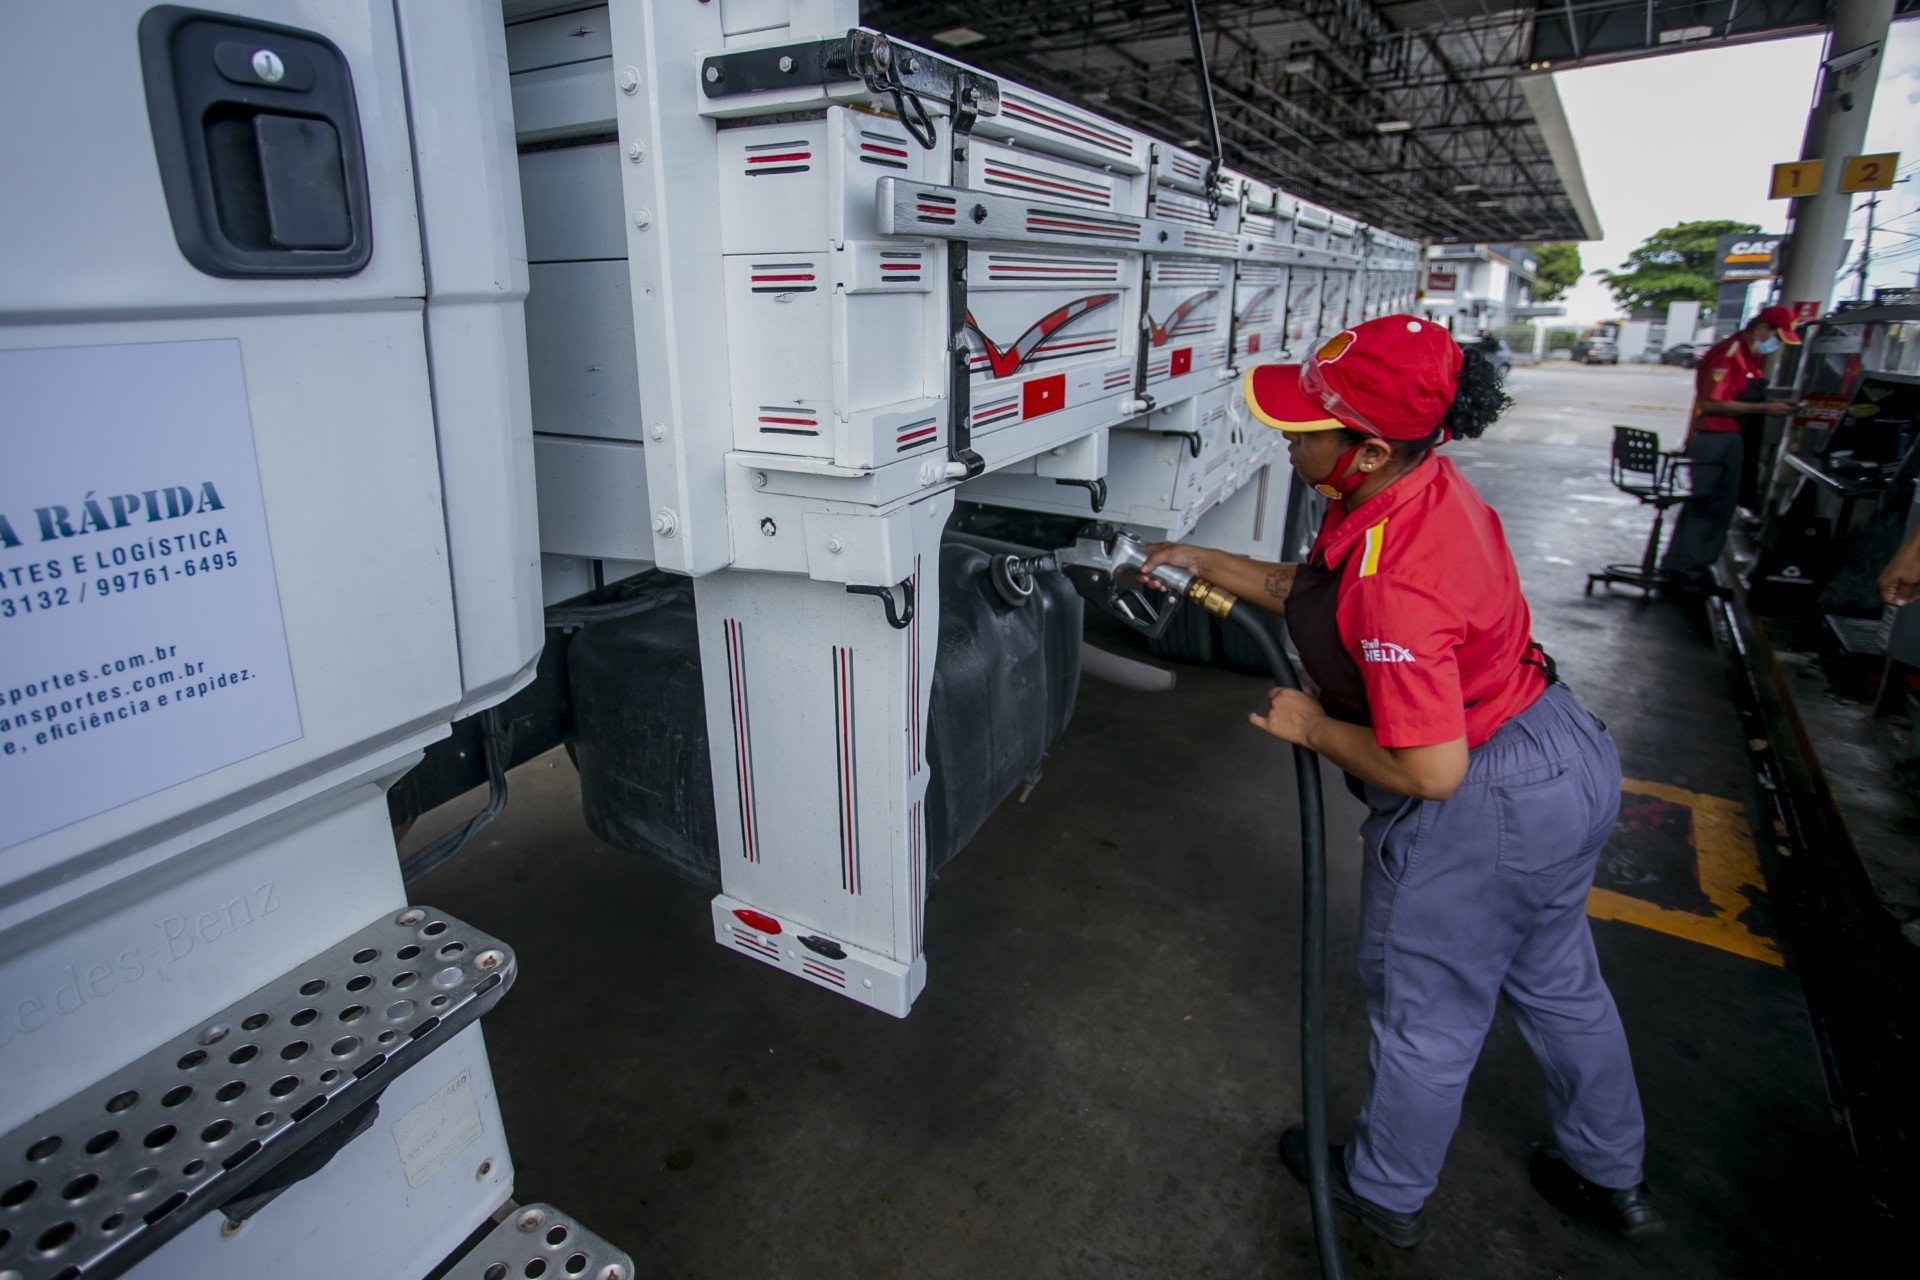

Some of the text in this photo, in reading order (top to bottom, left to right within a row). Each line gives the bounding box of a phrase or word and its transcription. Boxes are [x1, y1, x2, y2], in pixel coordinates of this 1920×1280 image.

[1790, 169, 1802, 188] 1
[1859, 162, 1880, 183] 2
[0, 481, 226, 549] A RÁPIDA
[72, 555, 88, 575] E
[96, 528, 228, 569] LOGÍSTICA
[1, 551, 238, 618] 3132 / 99761-6495
[1364, 648, 1416, 662] HELIX
[0, 661, 205, 733] ansportes.com.br
[35, 700, 150, 745] eficiência
[157, 695, 169, 708] e
[175, 669, 257, 702] rapidez.
